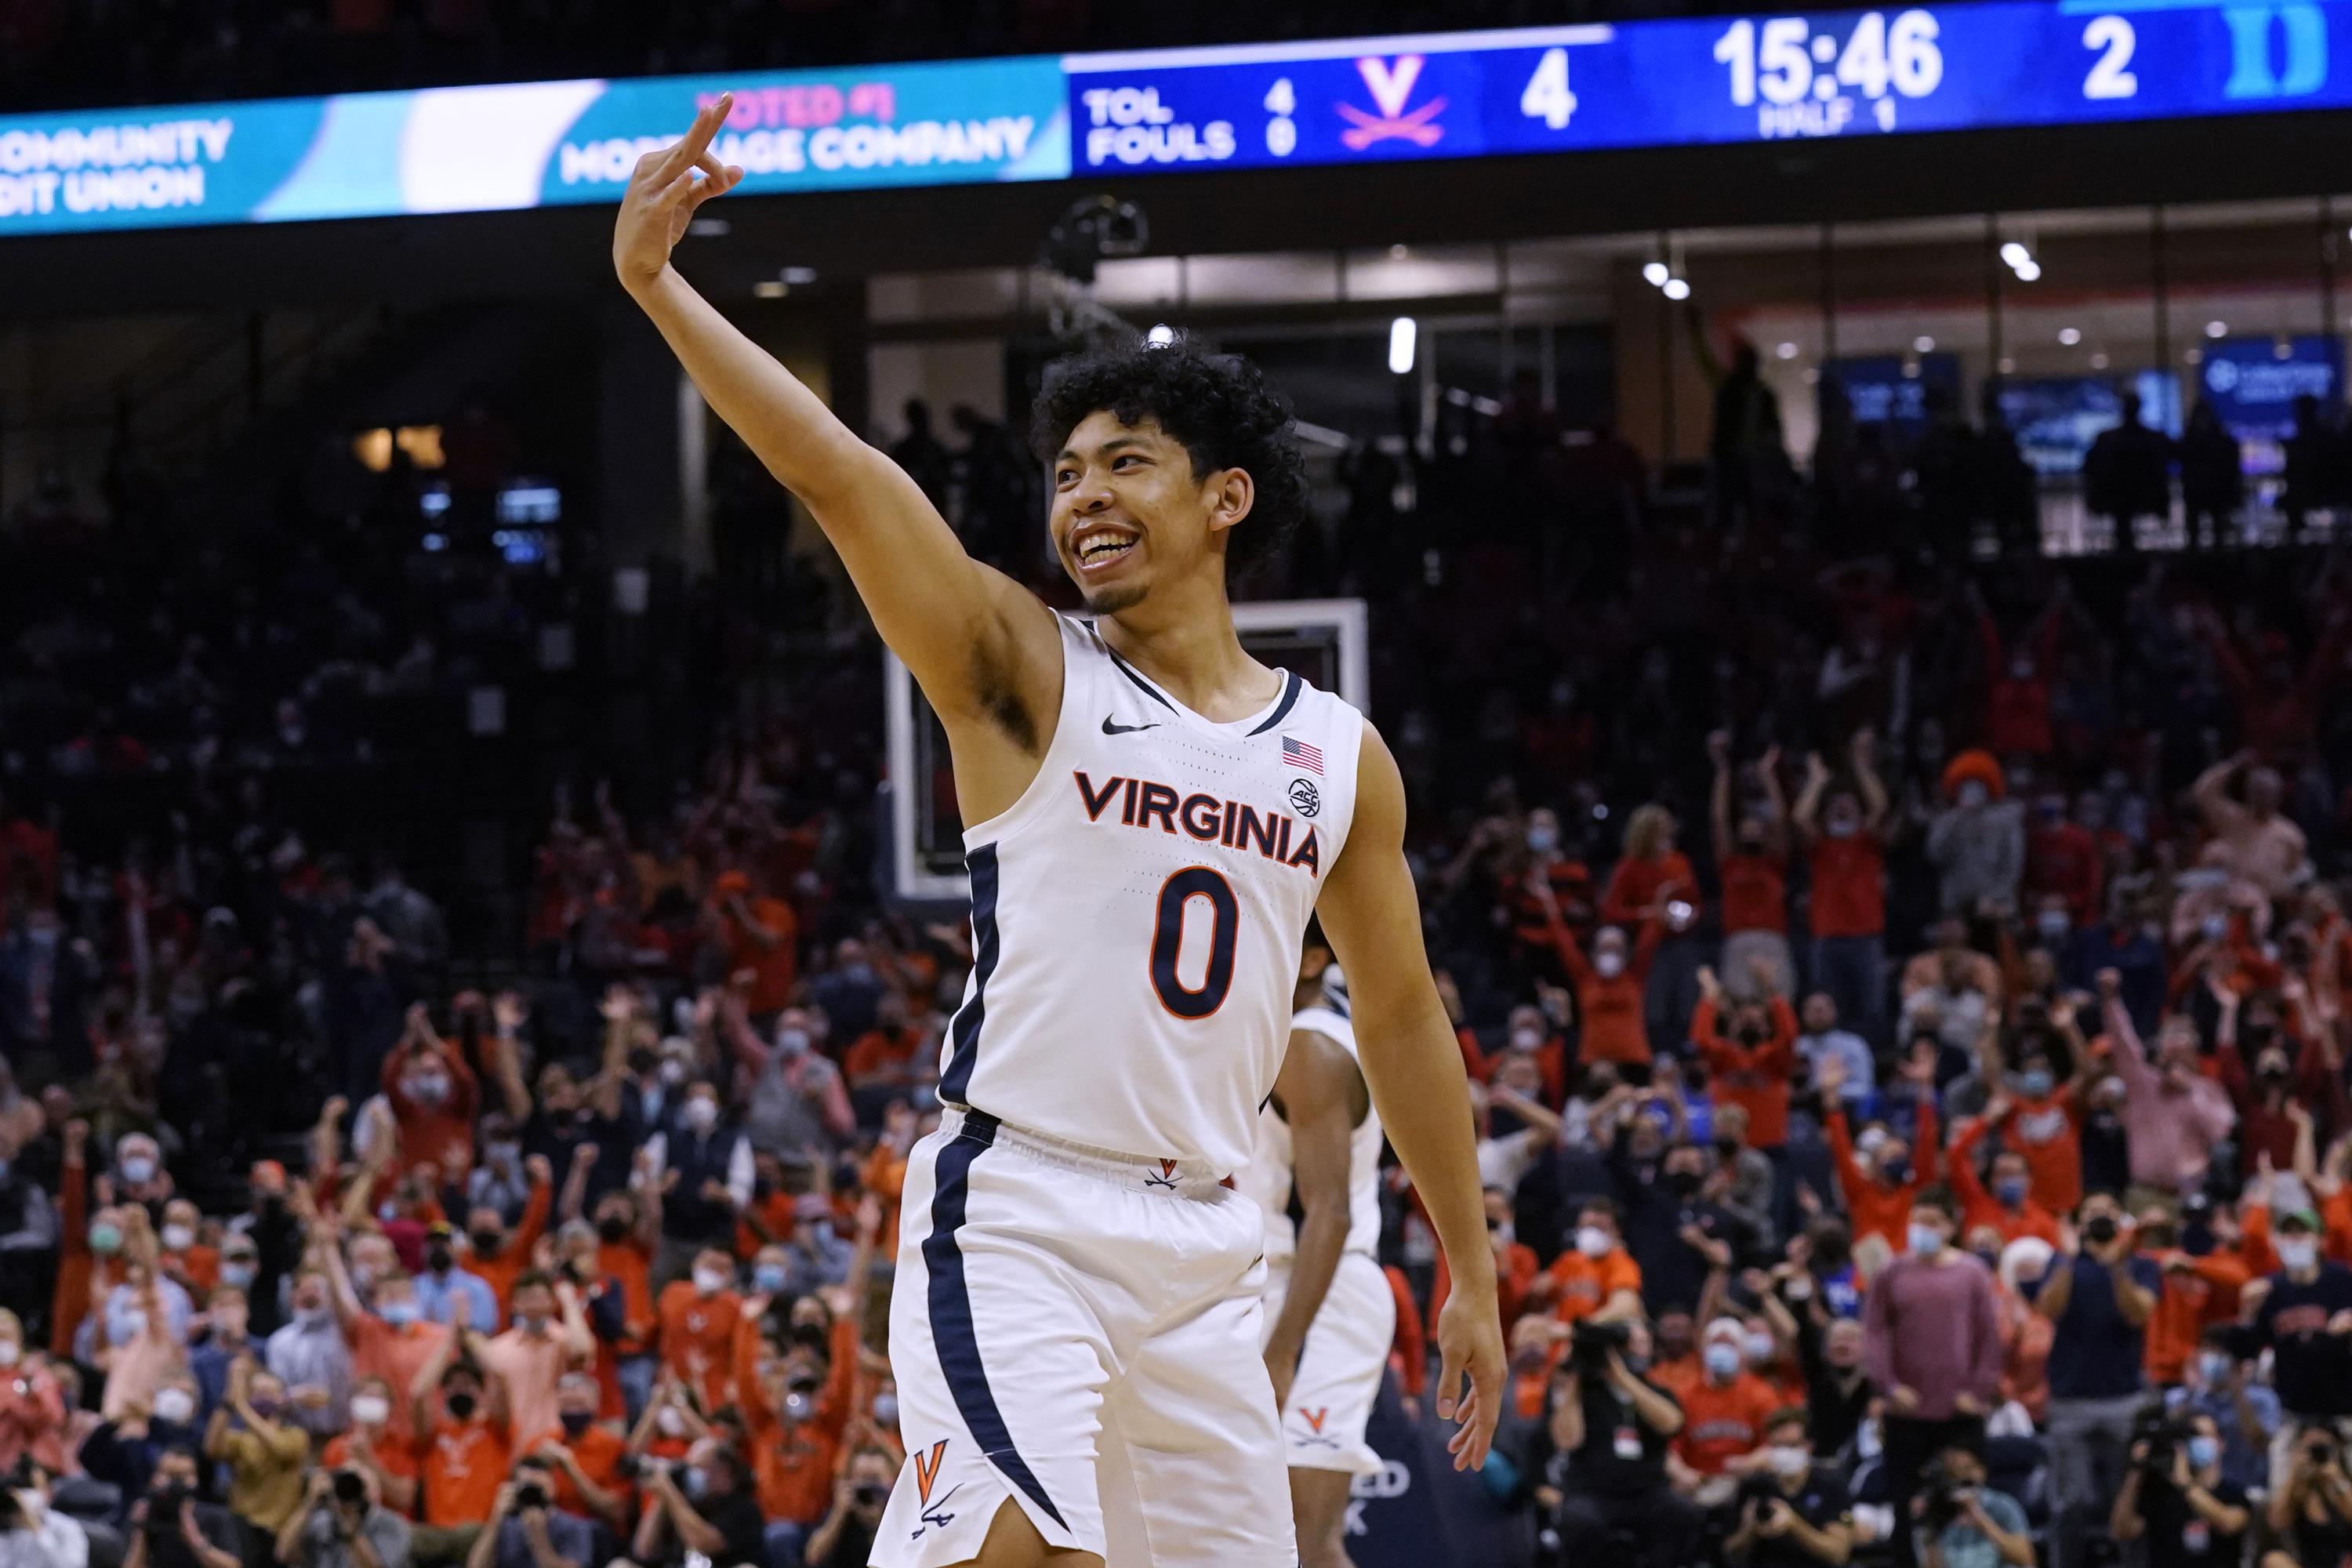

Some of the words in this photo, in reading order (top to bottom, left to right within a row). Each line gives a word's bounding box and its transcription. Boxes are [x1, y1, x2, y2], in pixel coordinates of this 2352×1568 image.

[1713, 9, 1944, 107] 15:46
[2082, 14, 2138, 100] 2
[1082, 86, 1174, 127] TOL
[1263, 78, 1296, 118] 4
[1520, 47, 1577, 129] 4
[809, 114, 1036, 171] COMPANY
[1087, 119, 1237, 166] FOULS
[1758, 95, 1854, 140] HALF
[63, 163, 205, 212] UNION
[1073, 771, 1319, 878] VIRGINIA
[1293, 789, 1319, 807] ACC
[1149, 865, 1240, 1019] 0
